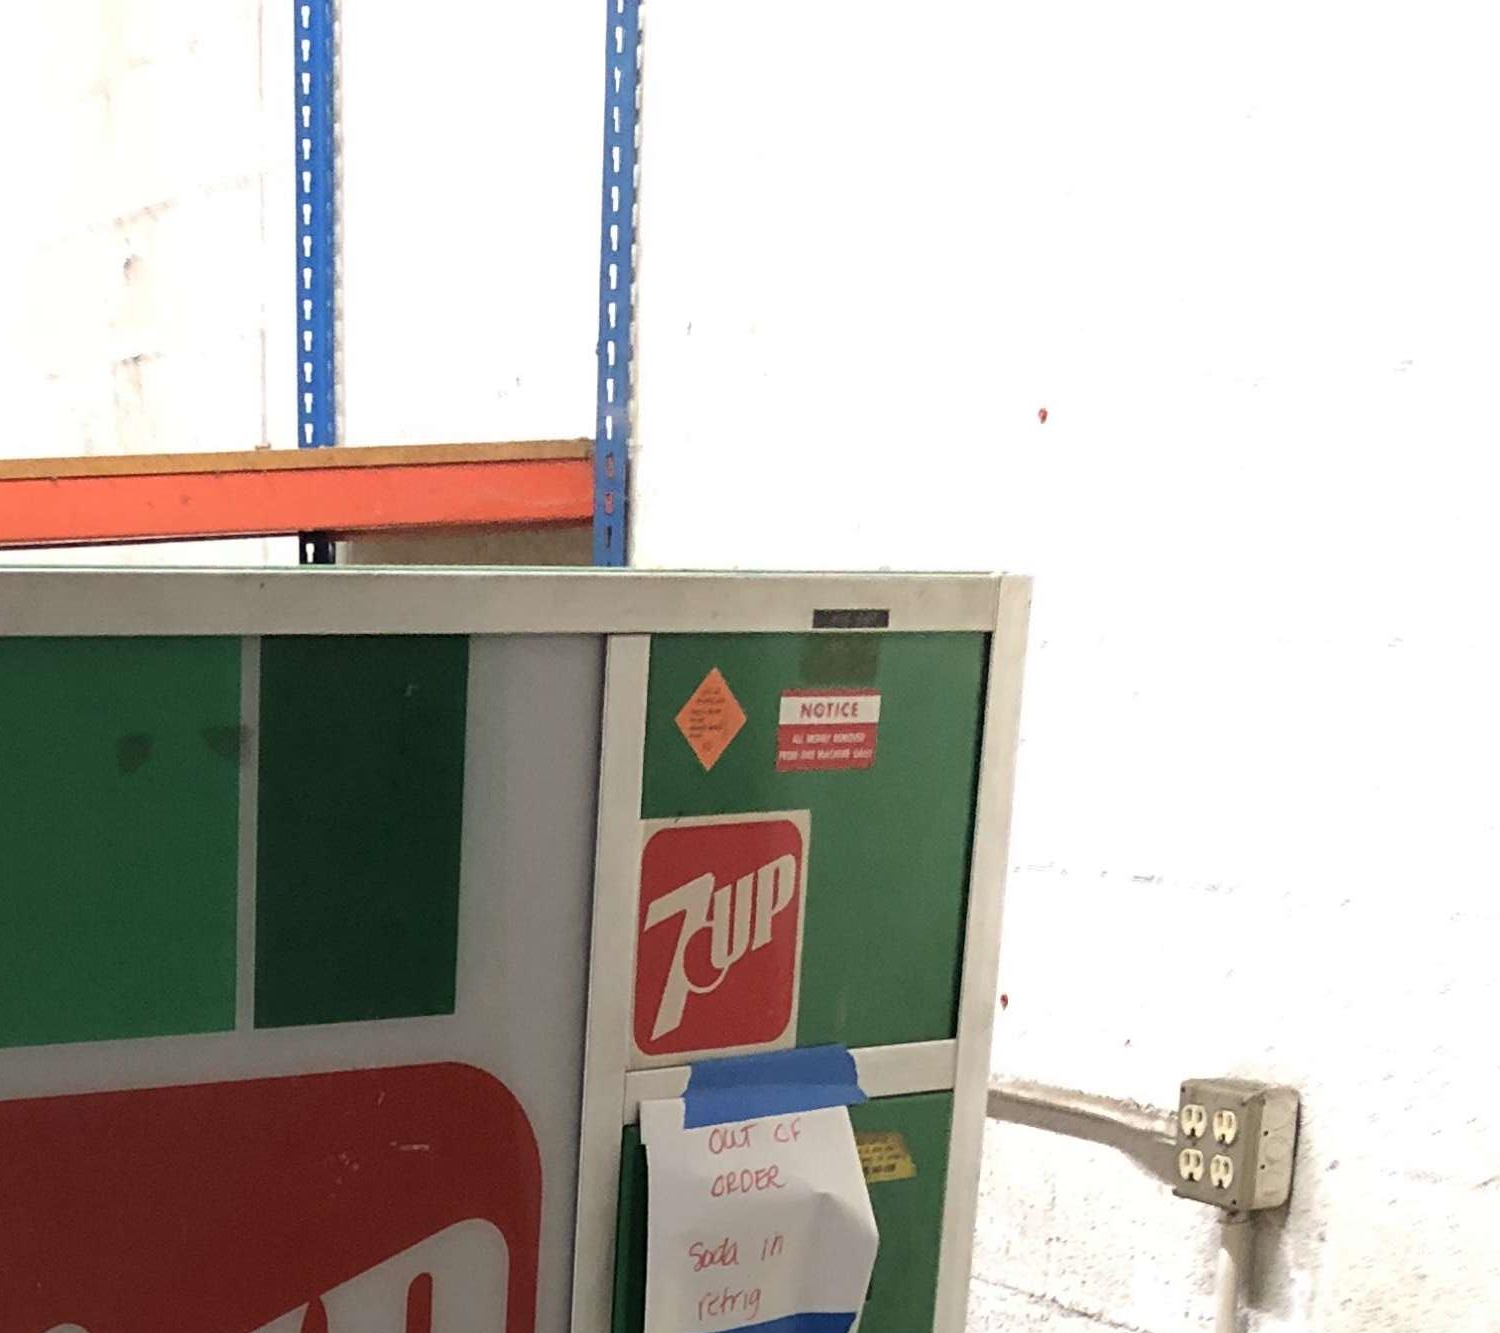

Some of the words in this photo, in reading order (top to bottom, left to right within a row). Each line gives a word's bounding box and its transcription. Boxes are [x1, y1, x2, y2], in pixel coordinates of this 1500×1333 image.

[800, 702, 858, 719] NOTICE
[644, 854, 796, 1041] 7UP
[709, 1123, 753, 1154] OUT
[711, 1165, 786, 1197] ORDER
